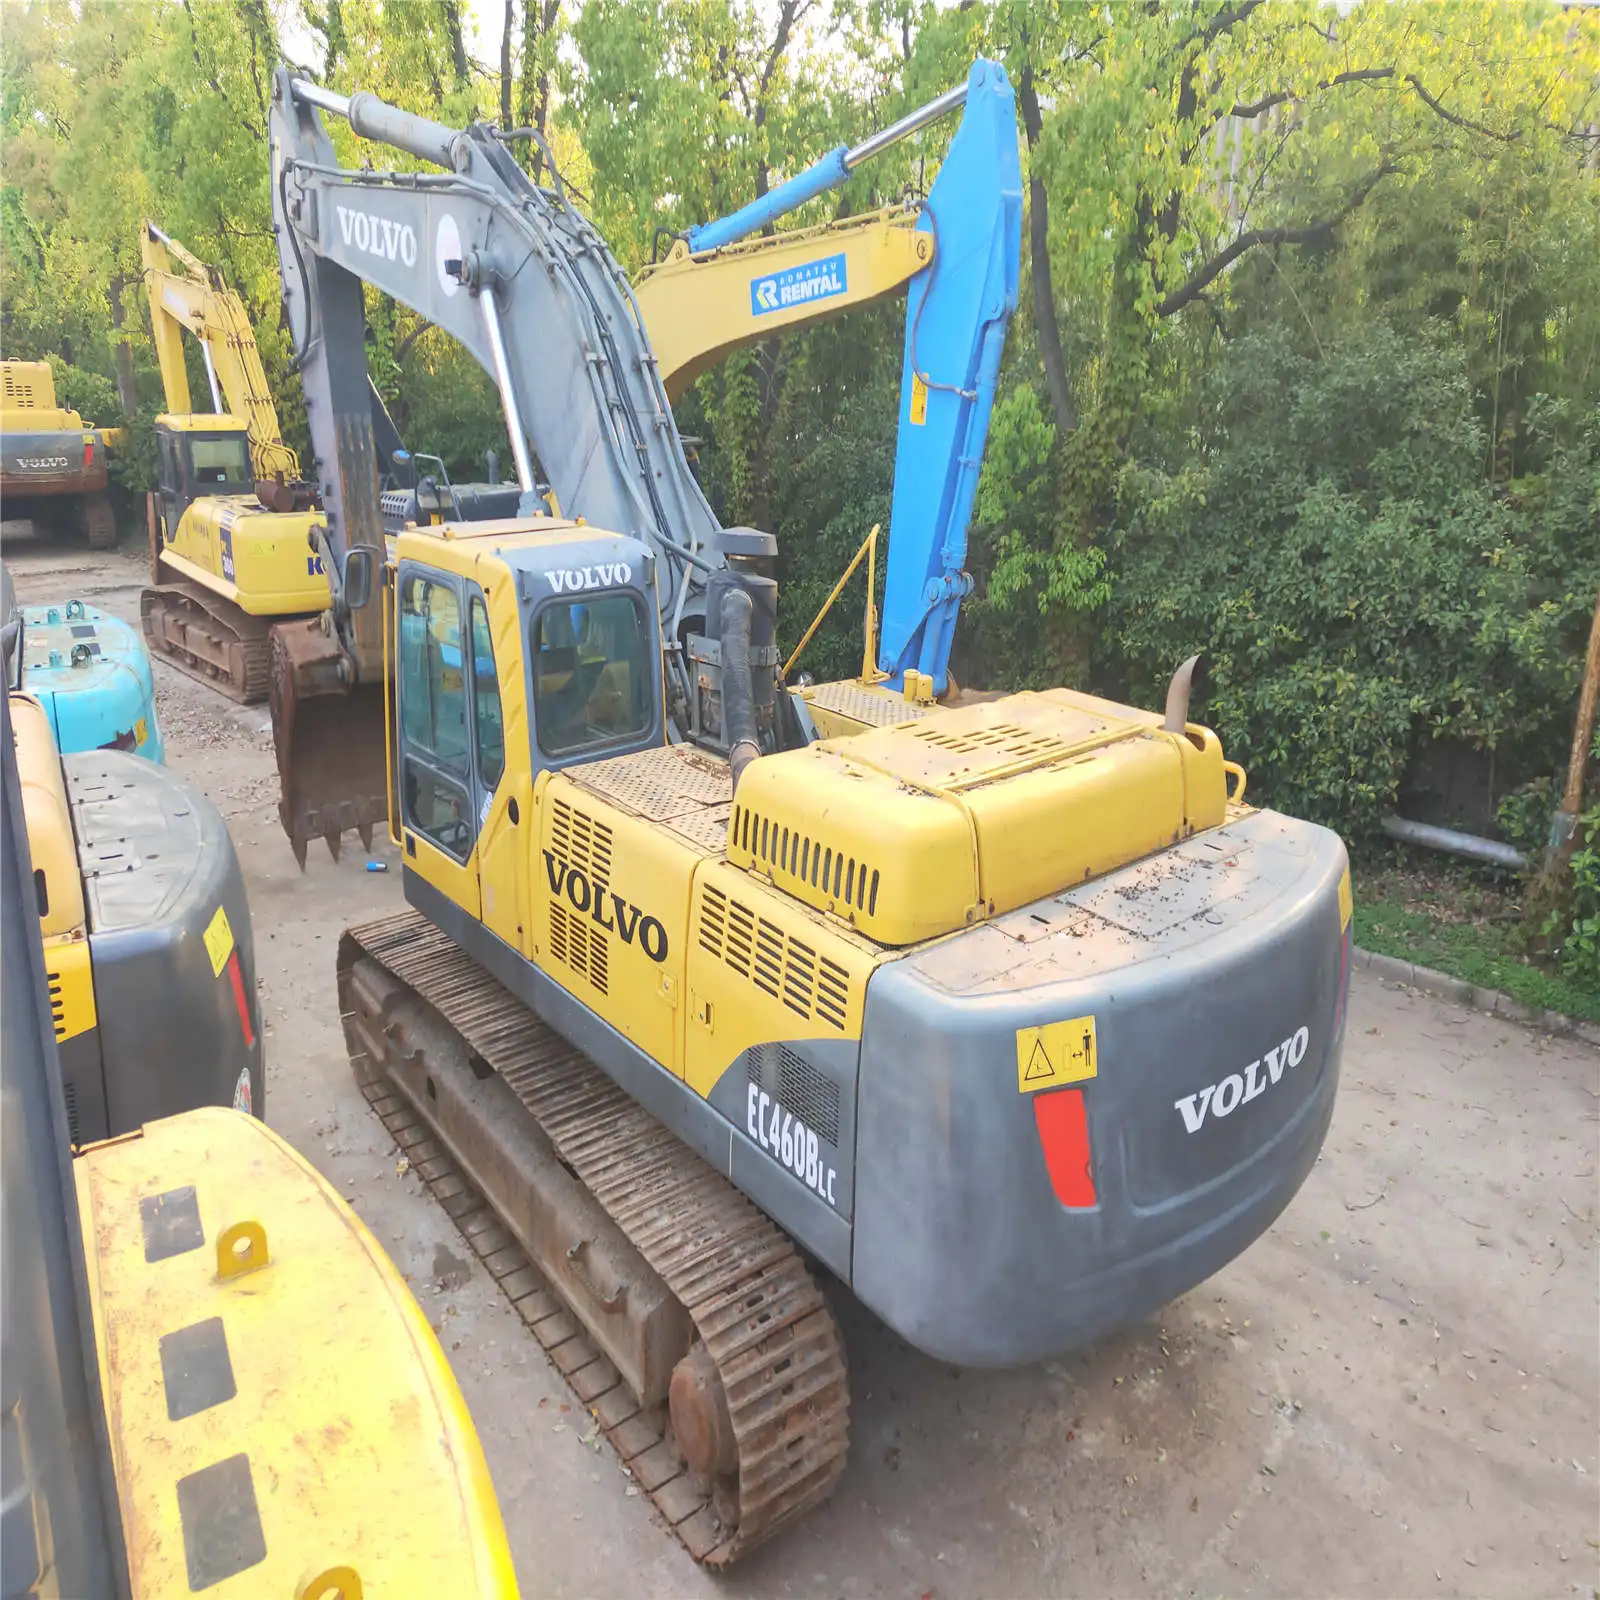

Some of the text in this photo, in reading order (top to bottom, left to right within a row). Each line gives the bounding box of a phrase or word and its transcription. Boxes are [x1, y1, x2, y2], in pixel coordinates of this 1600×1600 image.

[336, 205, 417, 268] VOLVO
[780, 272, 842, 305] RENTAL
[16, 456, 68, 468] VOLVO
[543, 562, 632, 593] VOLVO
[542, 848, 669, 963] VOLVO
[1173, 1025, 1310, 1134] VOLVO
